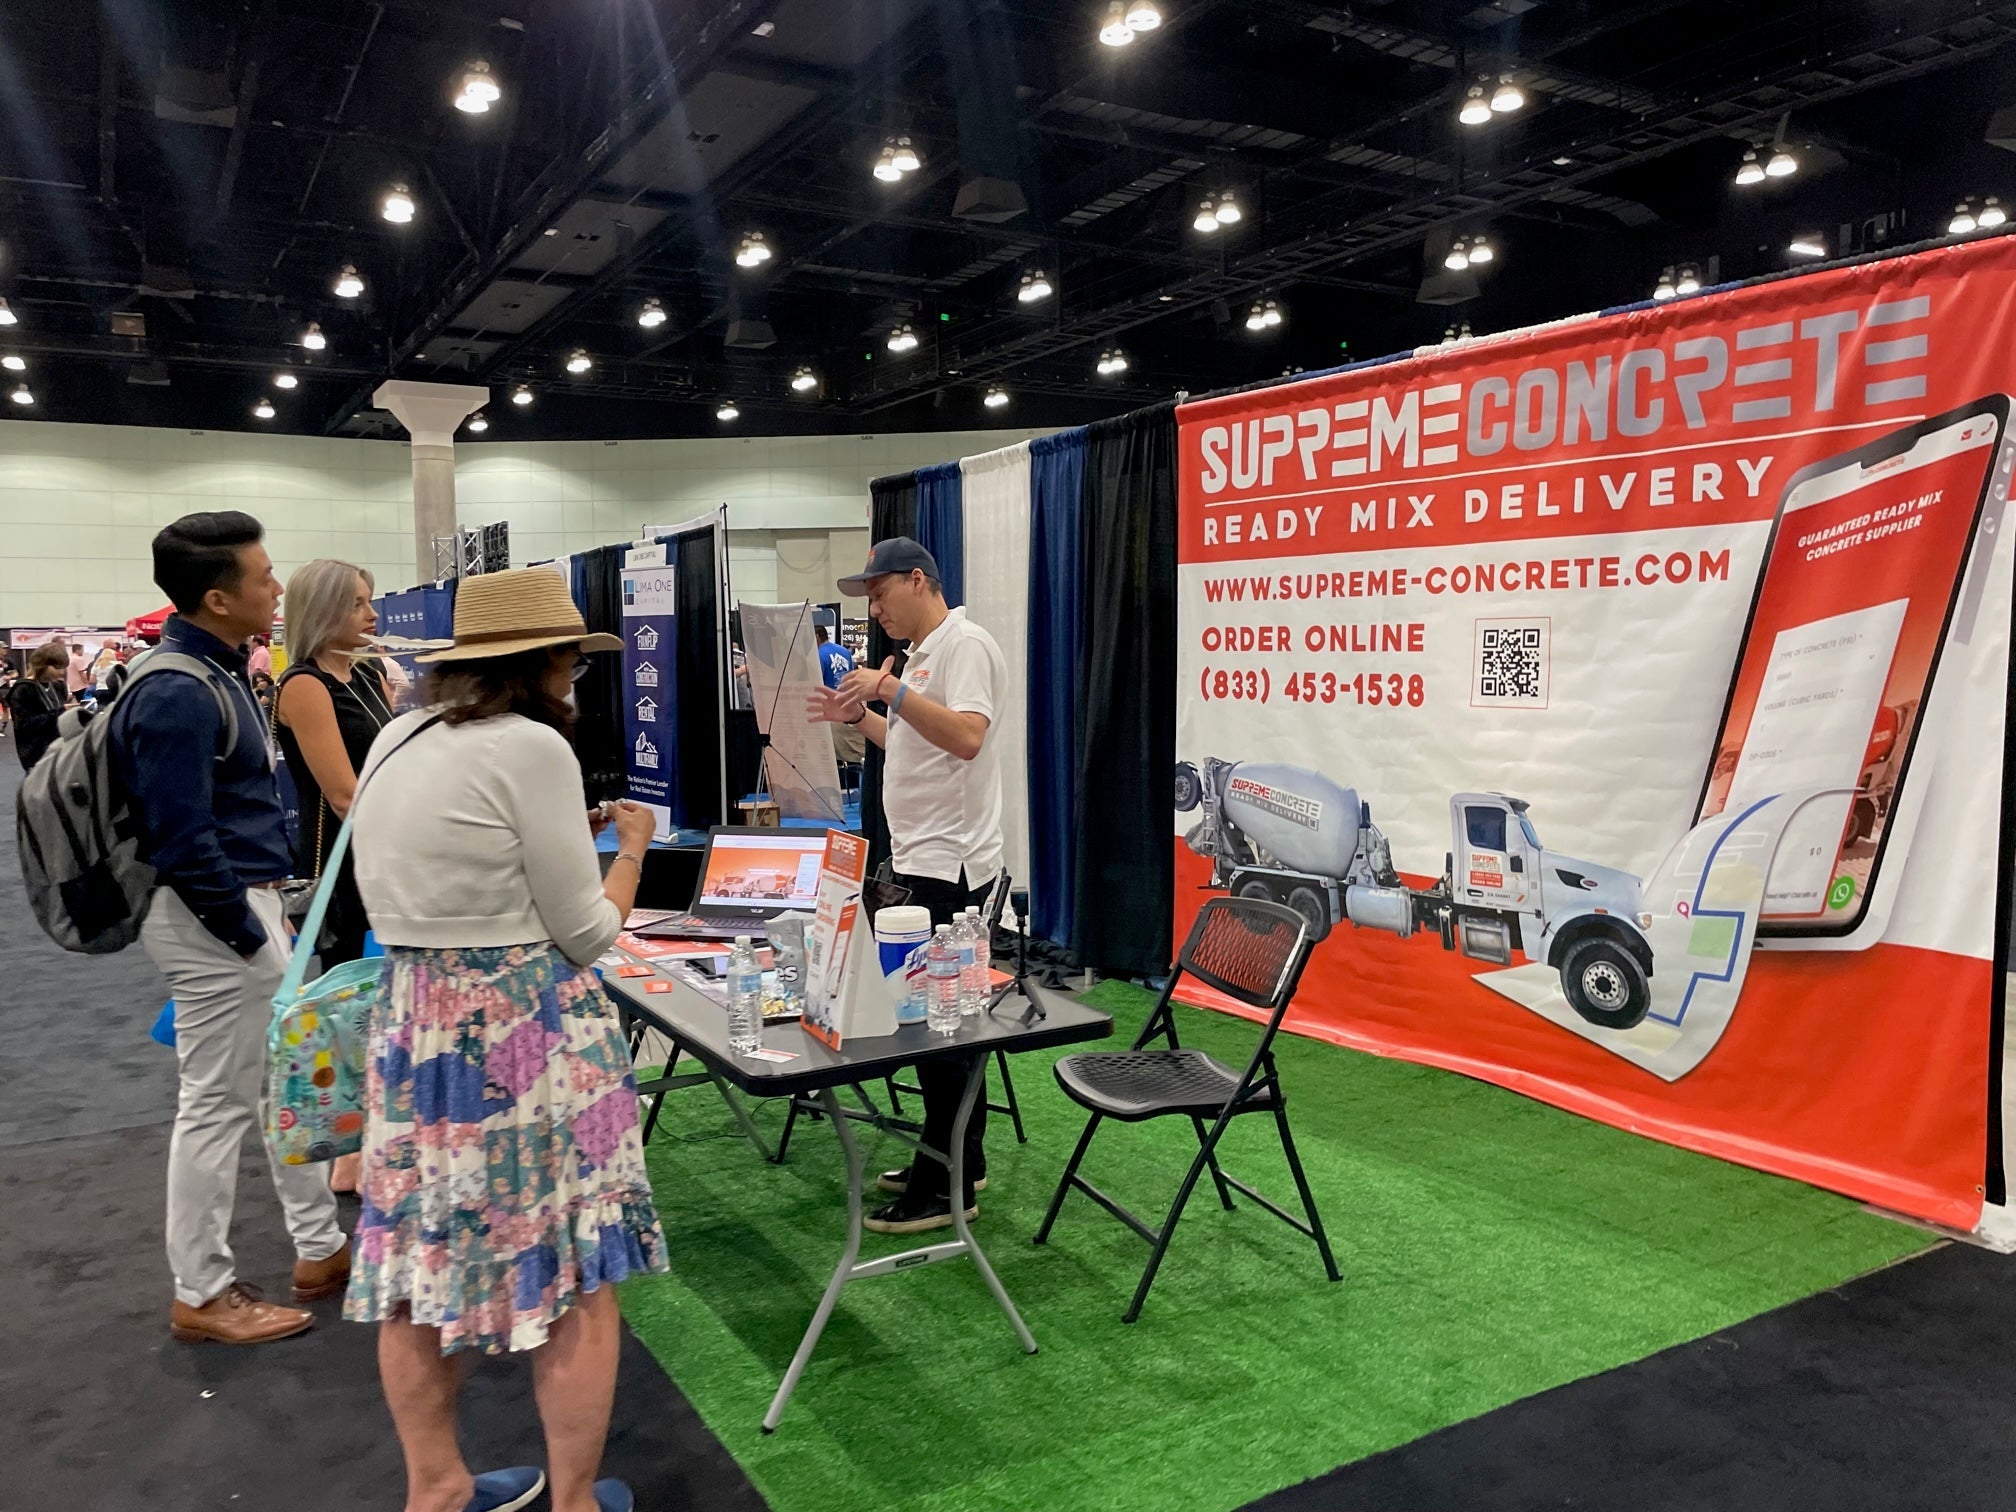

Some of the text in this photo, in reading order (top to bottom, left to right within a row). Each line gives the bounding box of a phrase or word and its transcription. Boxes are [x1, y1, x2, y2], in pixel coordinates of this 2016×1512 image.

[1204, 456, 1774, 546] READY MIX DELIVERY
[1797, 489, 1944, 548] GUARANTEED READY MIX
[1805, 514, 1923, 561] CONCRETE SUPPLIER
[635, 578, 673, 594] LIMA ONE
[1204, 549, 1731, 603] WWW.SUPREME-CONCRETE.COM
[1201, 623, 1425, 652] ORDER ONLINE
[1201, 666, 1425, 707] (833) 453-1538
[1230, 791, 1306, 823] READY MIX DELIVERY
